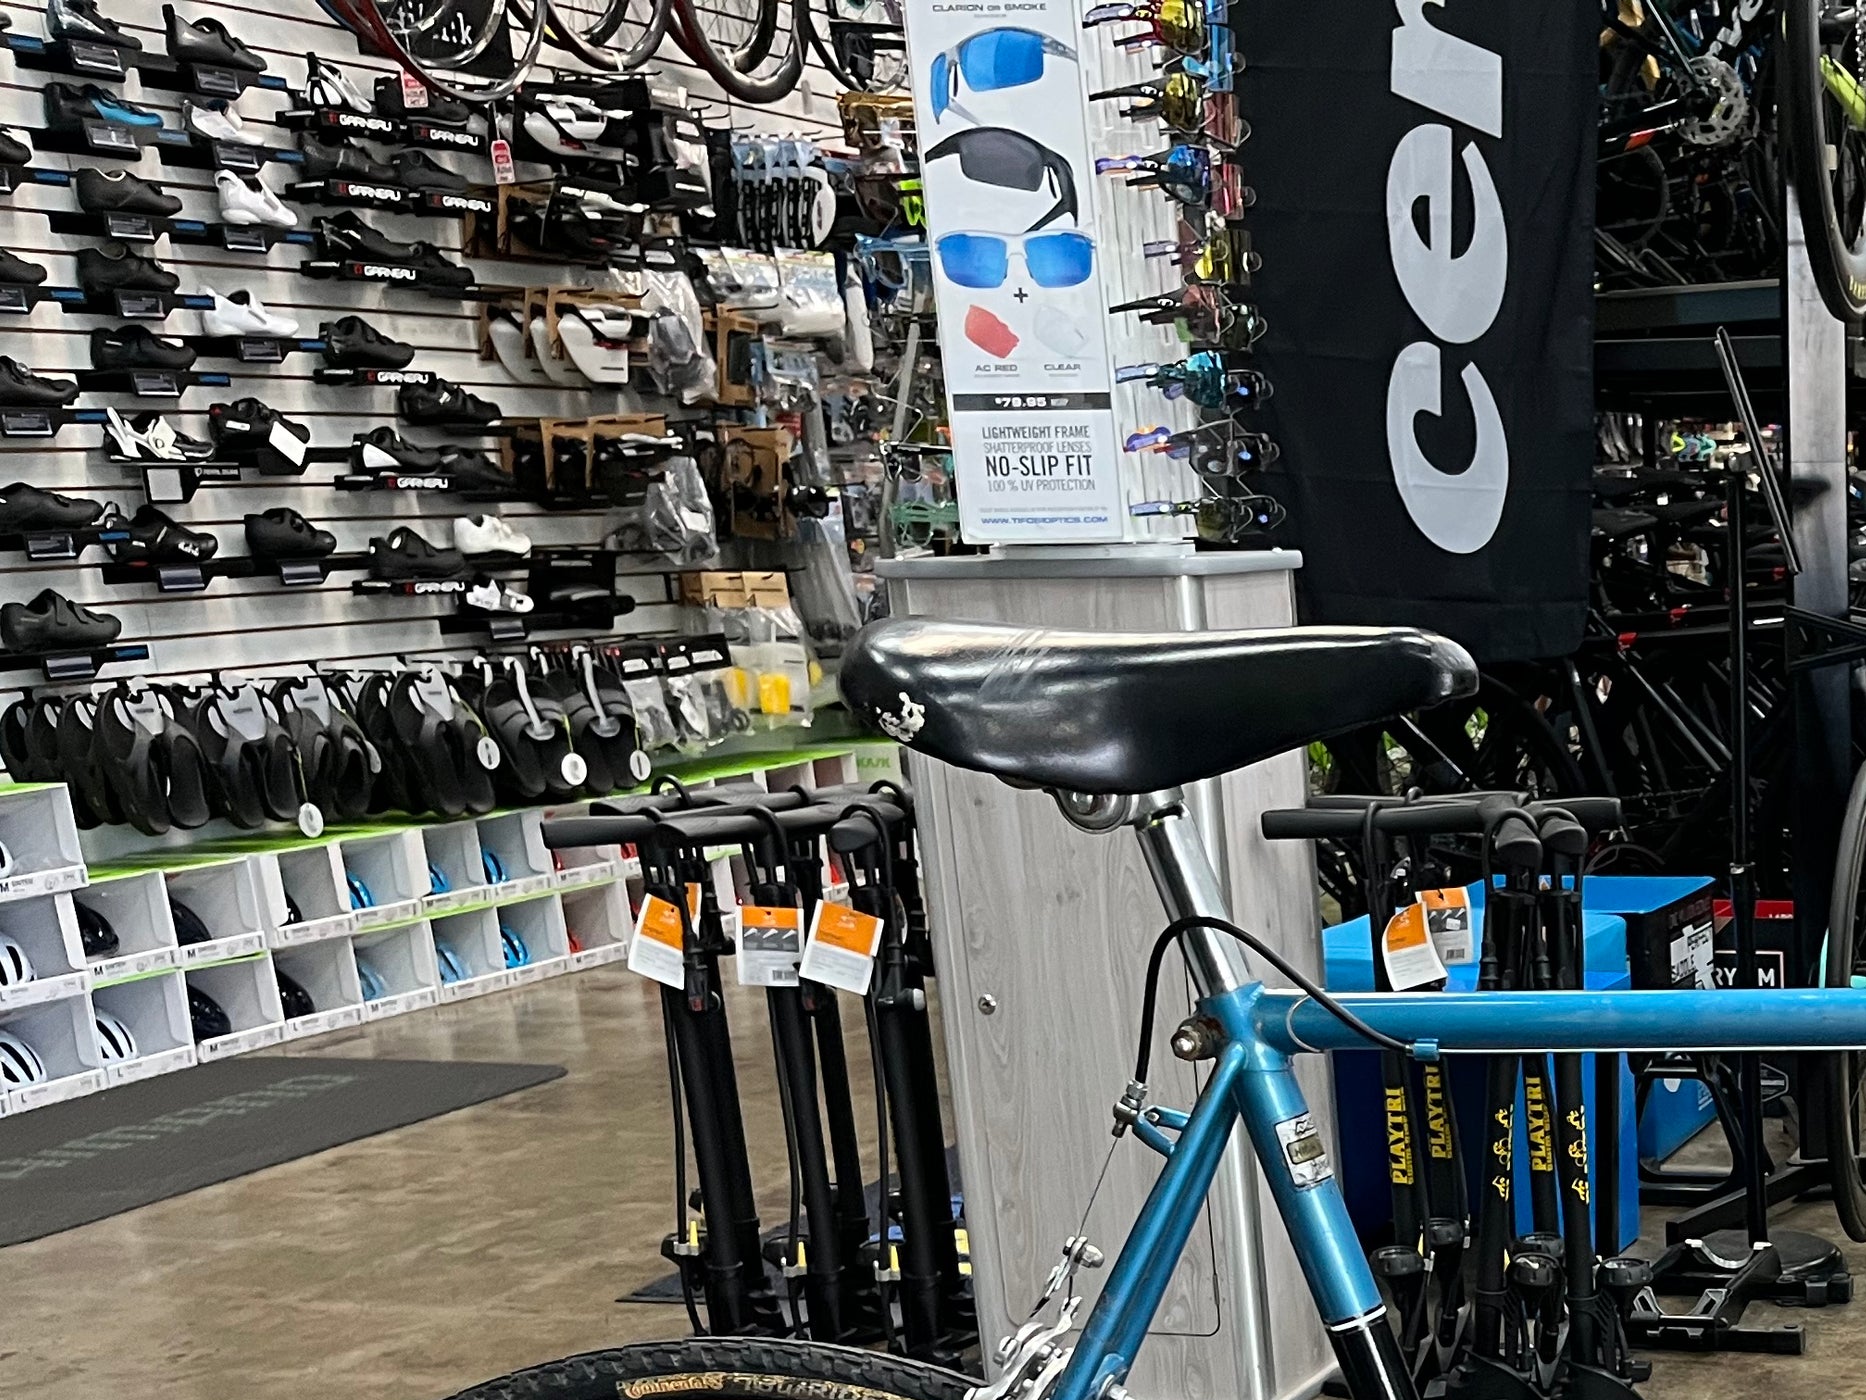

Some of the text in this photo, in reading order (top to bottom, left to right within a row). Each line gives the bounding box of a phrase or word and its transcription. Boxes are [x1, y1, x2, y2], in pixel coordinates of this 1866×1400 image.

[1004, 3, 1047, 11] SMOKE
[975, 364, 1018, 372] AC RED
[1043, 363, 1081, 371] CLEAR
[981, 425, 1090, 439] LIGHTWEIGHT FRAME
[983, 440, 1092, 454] SHATTERPROOF LENSES
[985, 454, 1092, 477] NO-SLIP FIT
[987, 480, 1005, 492] 100
[1021, 479, 1034, 491] UV
[1036, 479, 1096, 491] PROTECTION
[1425, 1064, 1447, 1158] PLAYTRI
[1525, 1076, 1547, 1171] PLAYTRI
[1385, 1086, 1408, 1184] PLAYTRI
